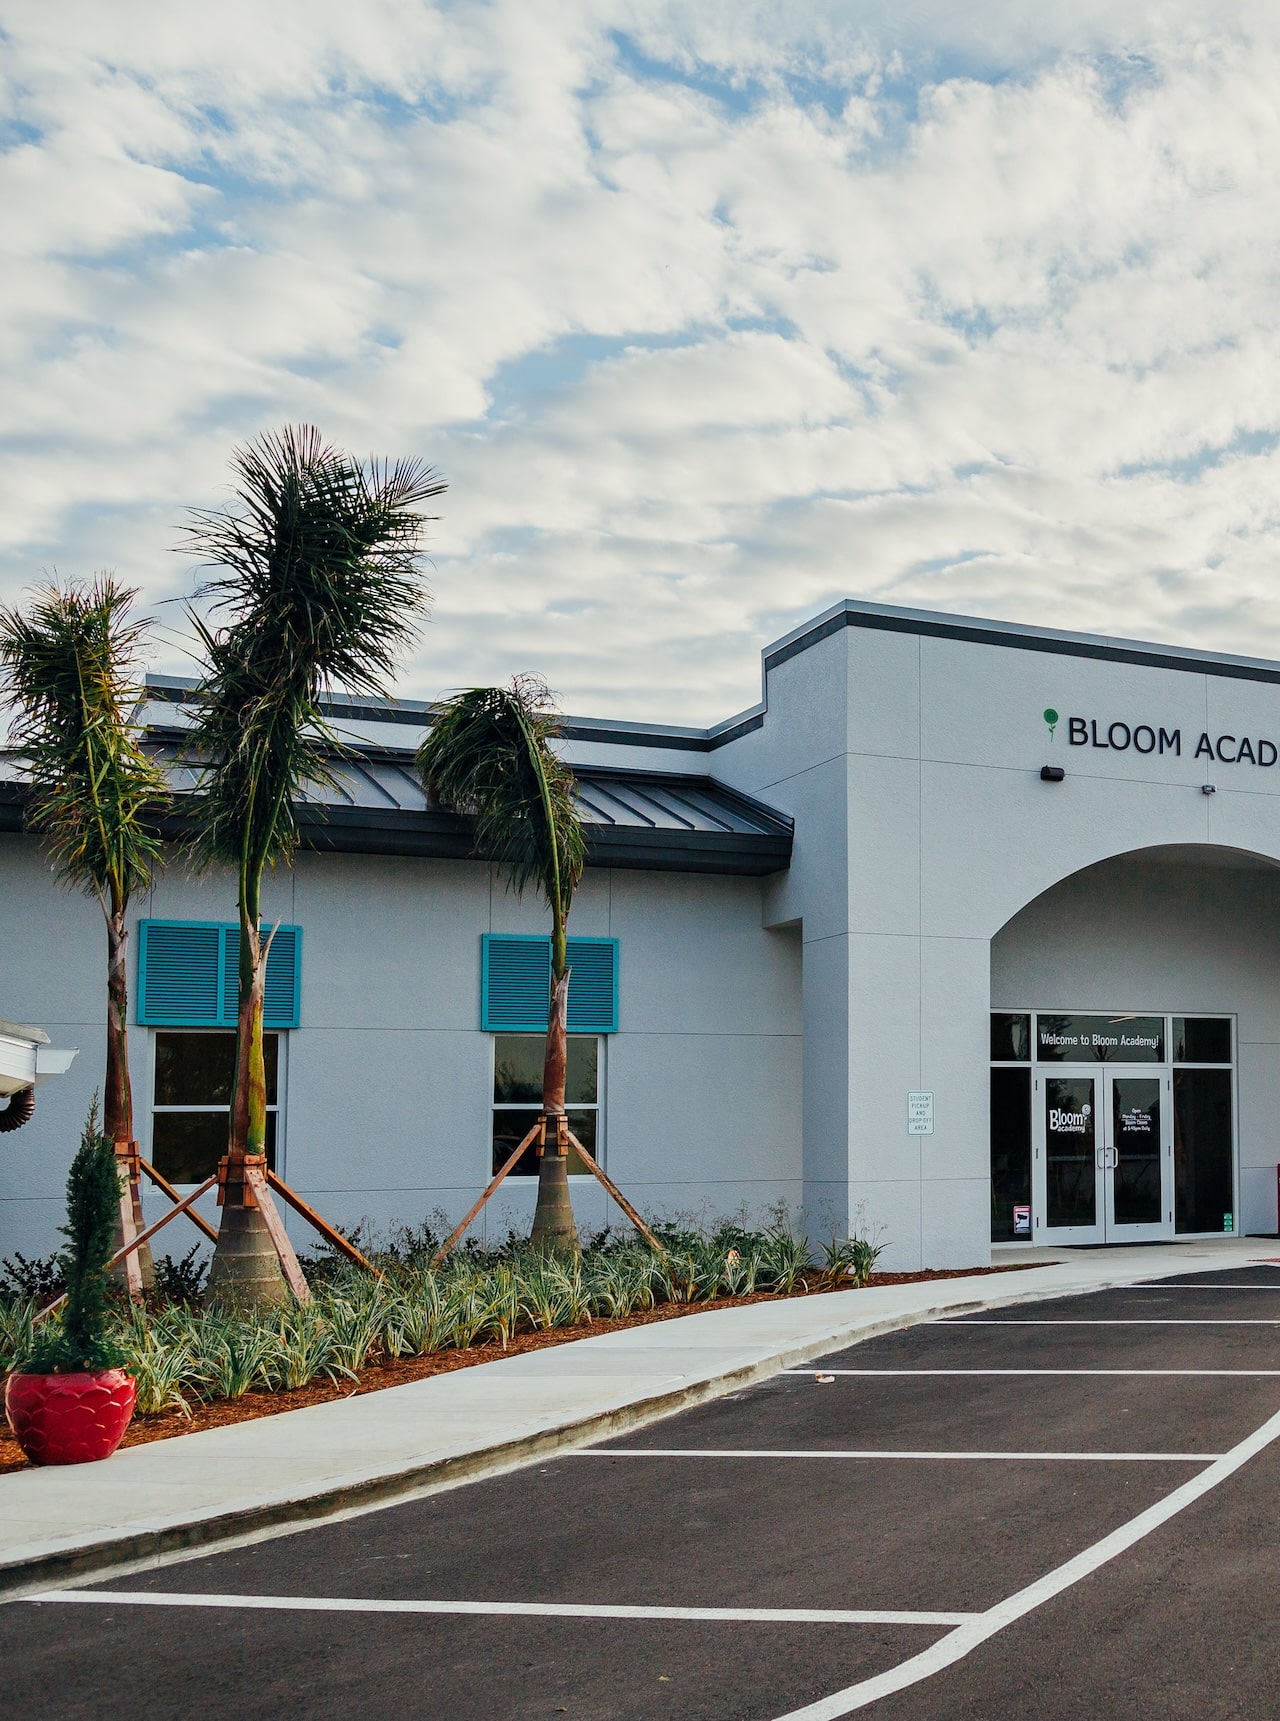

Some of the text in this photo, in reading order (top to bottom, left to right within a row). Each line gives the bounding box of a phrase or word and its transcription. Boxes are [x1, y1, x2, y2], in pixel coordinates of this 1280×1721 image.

[1068, 716, 1181, 756] BLOOM
[1040, 1032, 1159, 1049] Welcome to Bloom Academy!
[1049, 1108, 1083, 1130] Bloom
[1057, 1124, 1086, 1133] academy
